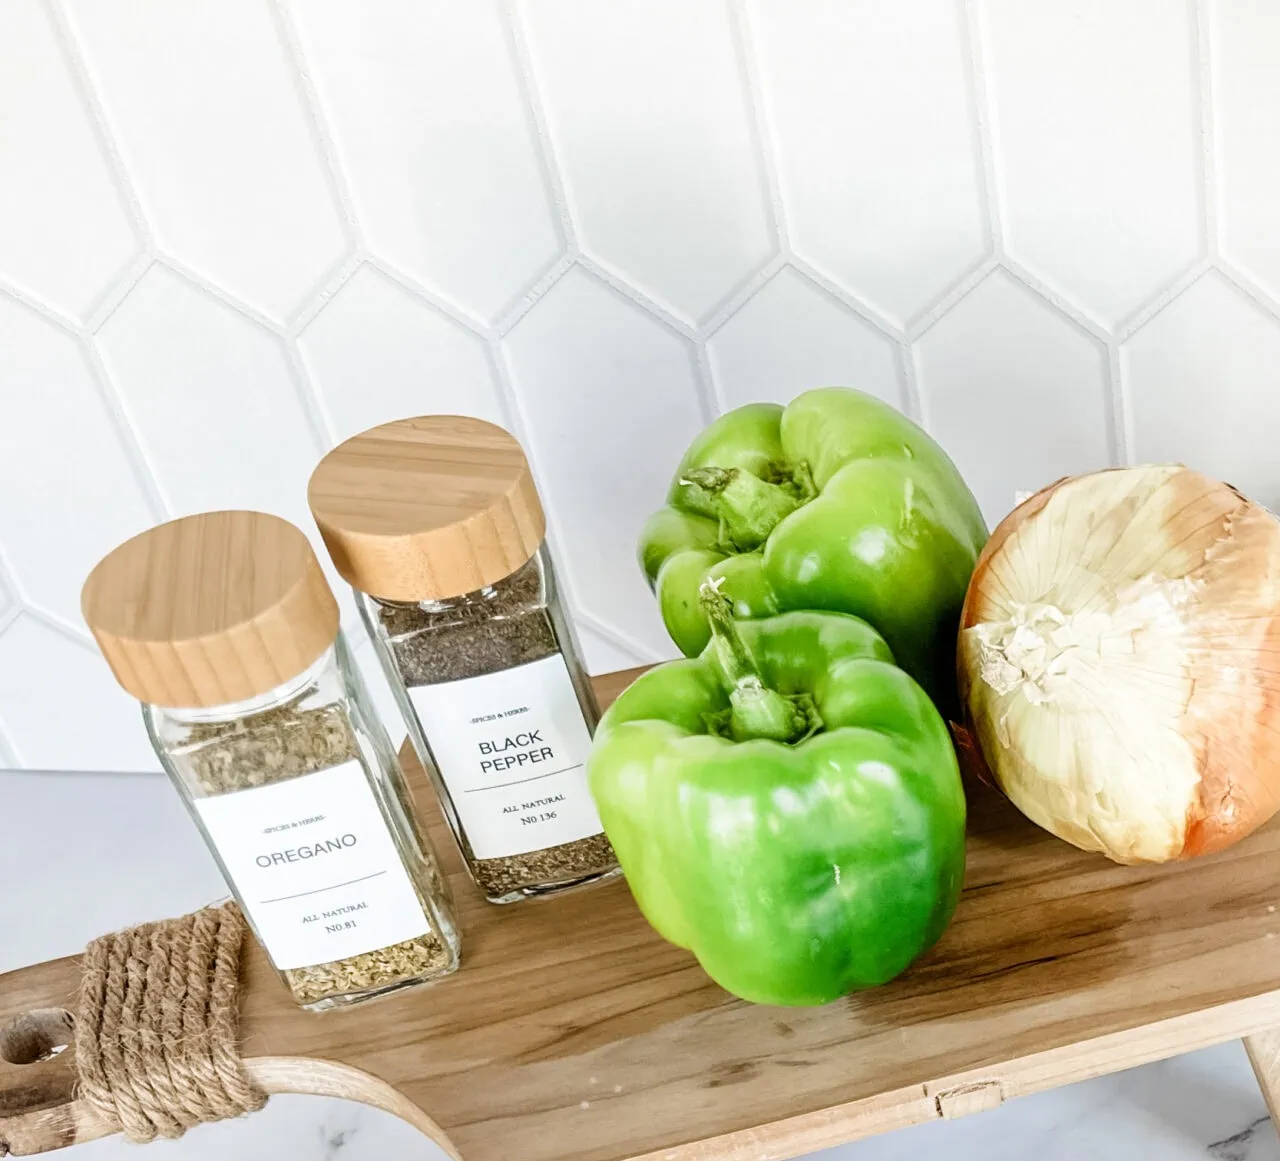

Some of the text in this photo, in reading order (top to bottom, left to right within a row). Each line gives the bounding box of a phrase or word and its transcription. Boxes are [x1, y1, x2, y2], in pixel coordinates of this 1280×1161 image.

[478, 729, 544, 755] BLACK
[480, 747, 554, 774] PEPPER
[502, 793, 566, 814] ALL NATURAL
[540, 810, 557, 821] 136
[255, 833, 357, 869] OREGANO
[302, 901, 369, 924] ALL NATURAL
